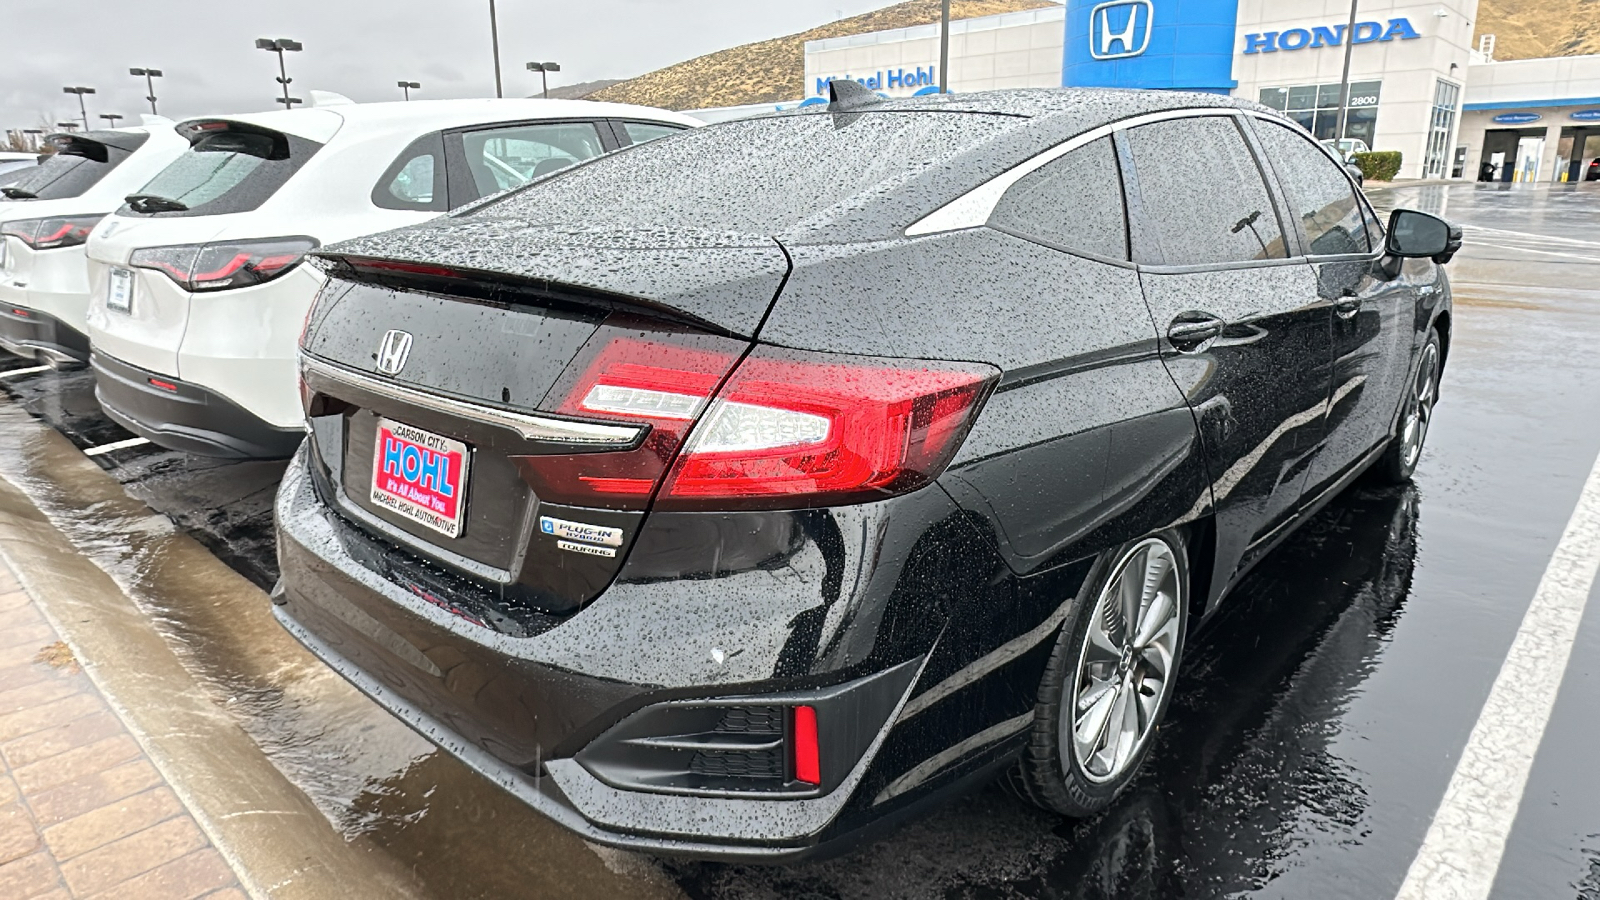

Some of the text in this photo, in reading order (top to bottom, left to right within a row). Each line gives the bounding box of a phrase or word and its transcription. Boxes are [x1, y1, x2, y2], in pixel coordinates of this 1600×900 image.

[1243, 17, 1421, 54] HONDA
[887, 65, 935, 88] Hohl
[1351, 96, 1377, 106] 2800
[396, 426, 446, 452] CARSON CITY
[383, 437, 454, 498] HOHL
[386, 478, 398, 493] It's
[397, 483, 408, 496] All
[407, 486, 431, 506] About
[397, 501, 415, 517] HOHL
[414, 508, 456, 534] AUTOMOTIVE
[559, 523, 612, 537] PLUG-IN
[566, 532, 604, 542] HYBRID
[562, 543, 611, 556] TOURING
